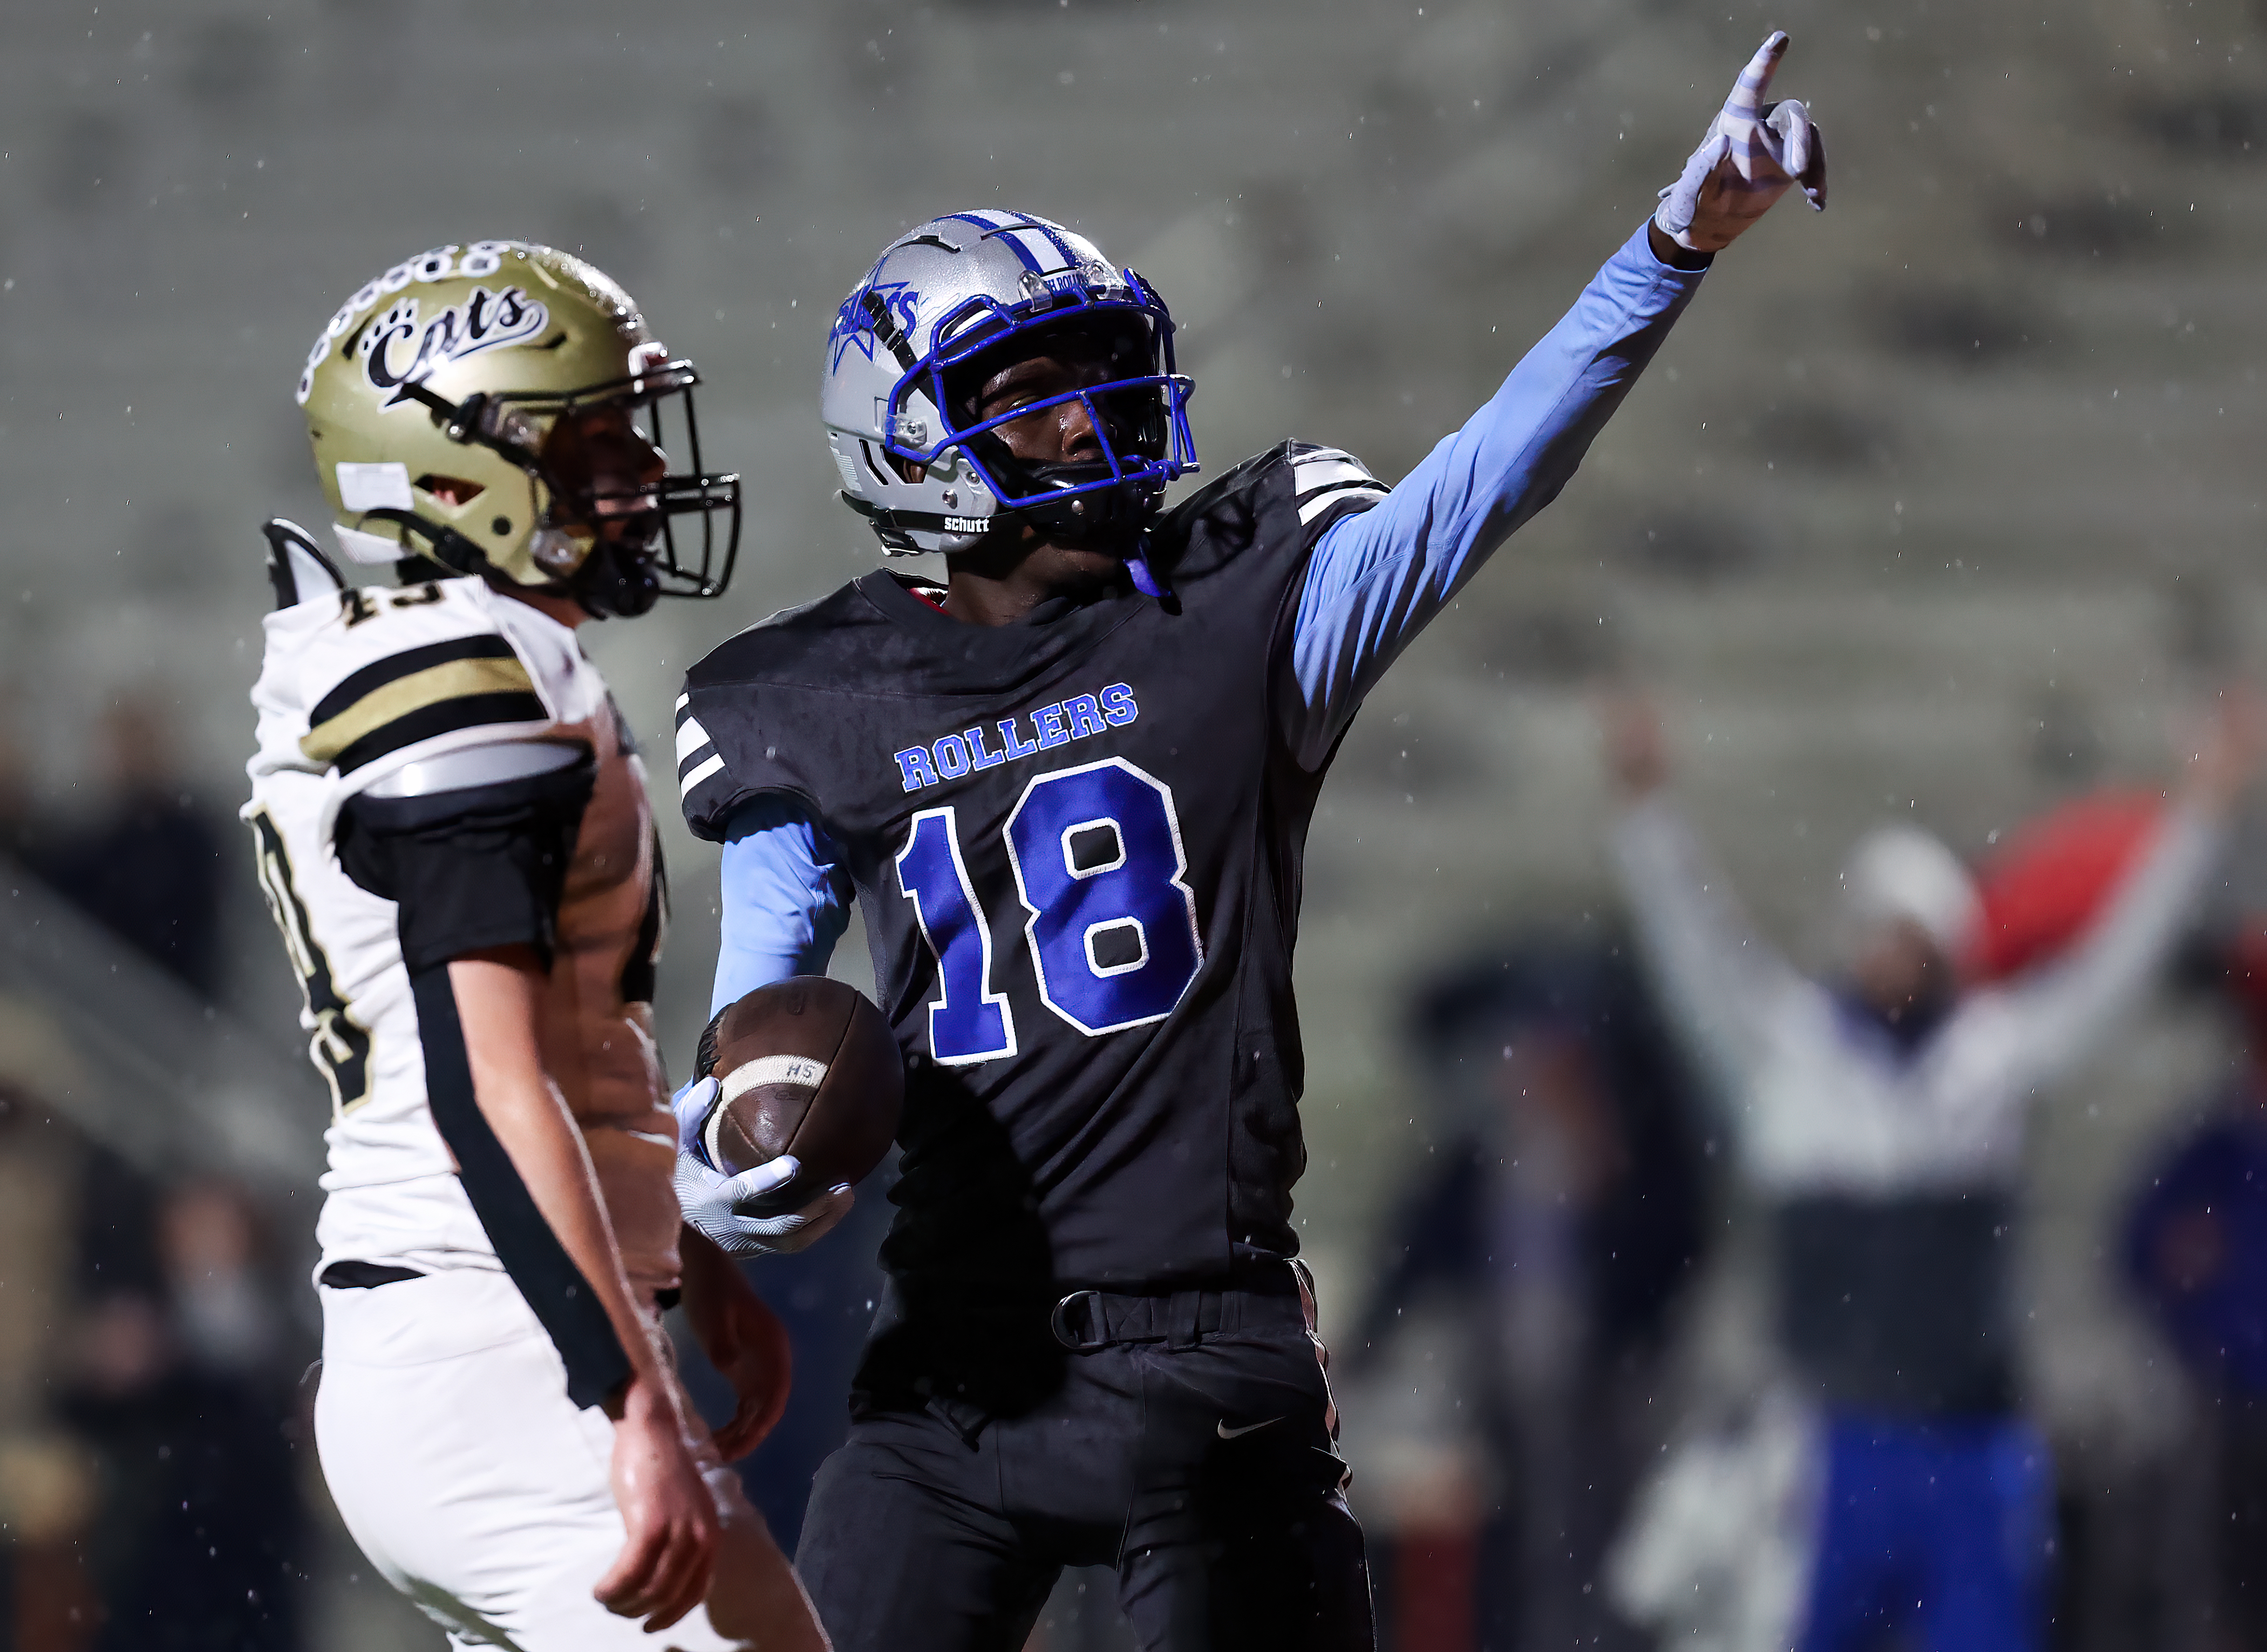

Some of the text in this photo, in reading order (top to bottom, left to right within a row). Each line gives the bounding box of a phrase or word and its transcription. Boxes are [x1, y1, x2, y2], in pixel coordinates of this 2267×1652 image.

[362, 286, 549, 398] Cats
[944, 516, 990, 533] schutt
[894, 681, 1140, 793] ROLLERS
[895, 756, 1204, 1066] 18
